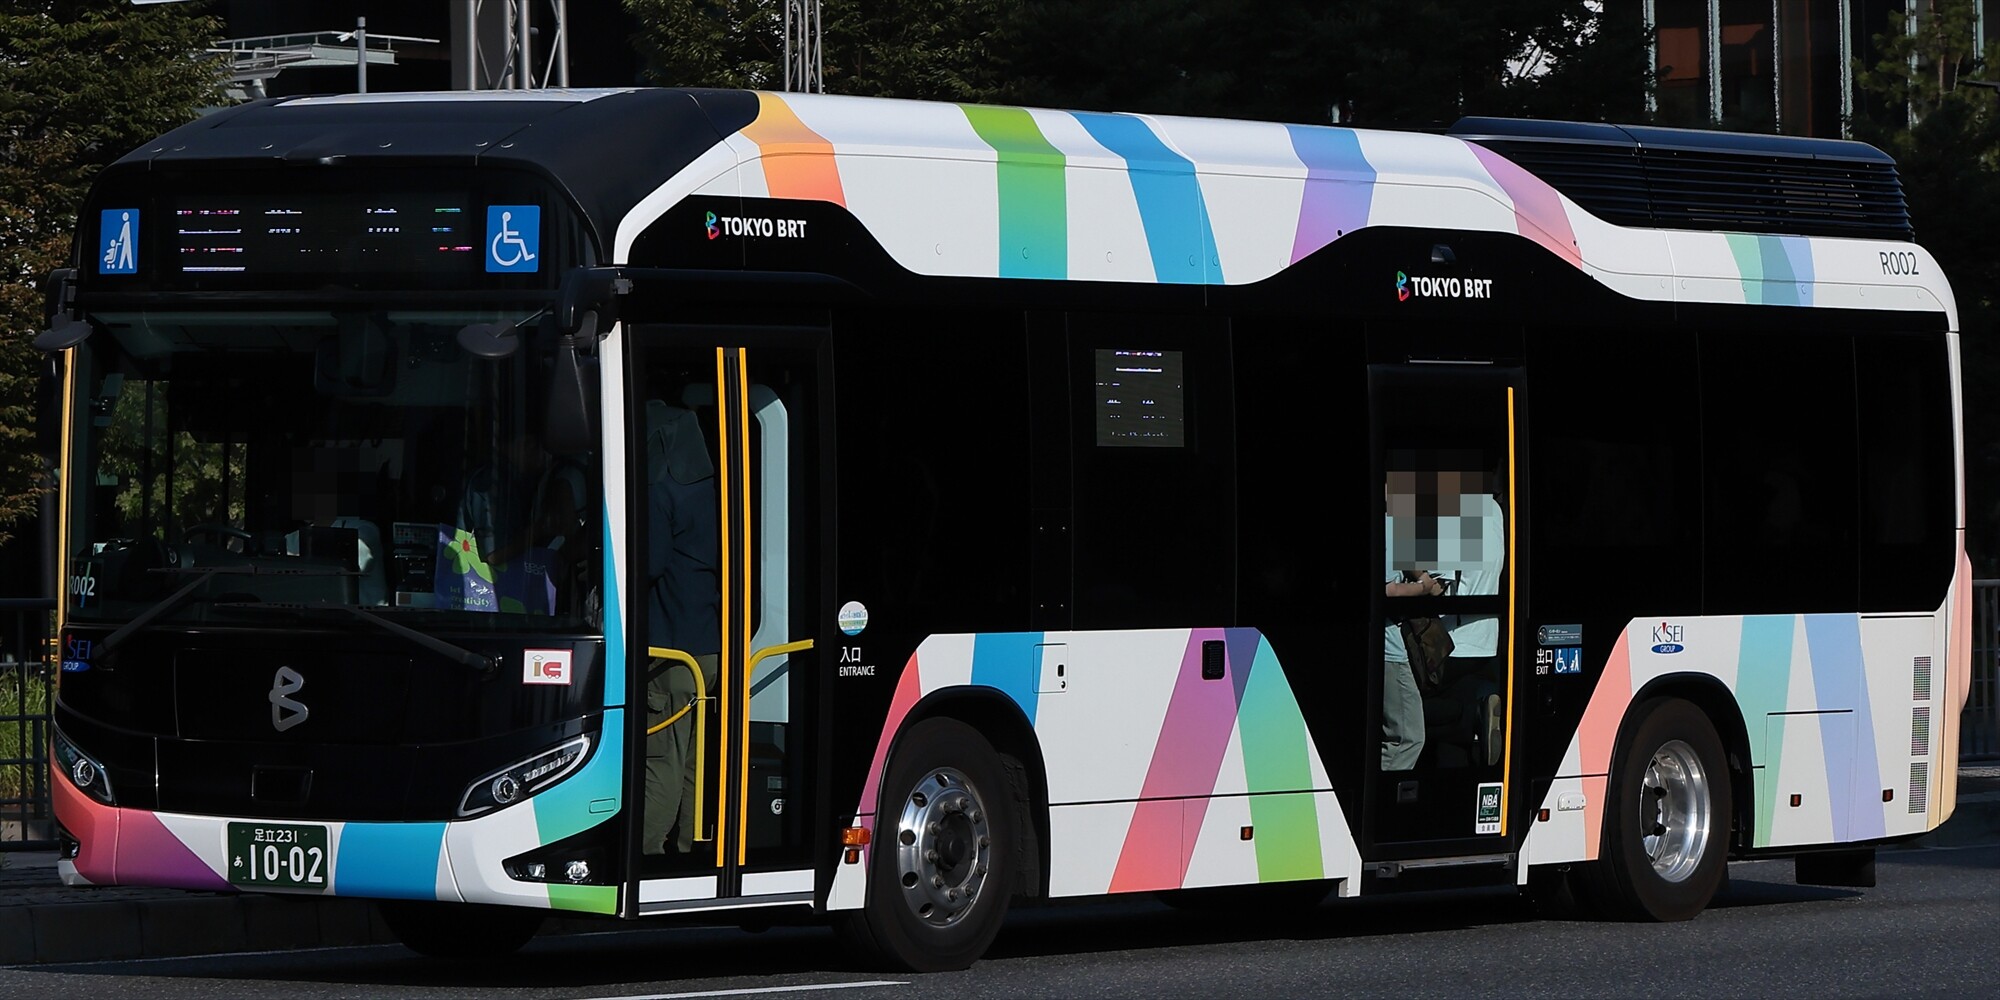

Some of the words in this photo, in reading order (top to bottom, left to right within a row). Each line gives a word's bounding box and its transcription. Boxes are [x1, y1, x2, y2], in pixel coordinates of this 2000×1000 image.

[721, 217, 774, 237] TOKYO
[777, 219, 807, 238] BRT
[1879, 251, 1920, 275] R002
[1411, 277, 1460, 298] TOKYO
[1464, 278, 1492, 299] BRT
[840, 646, 861, 663] 入口
[1536, 648, 1553, 664] 出口
[839, 665, 876, 677] ENTRANCE
[1536, 665, 1549, 675] EXIT
[1482, 794, 1498, 806] NBA
[233, 855, 244, 868] あ
[250, 844, 323, 883] 10-02
